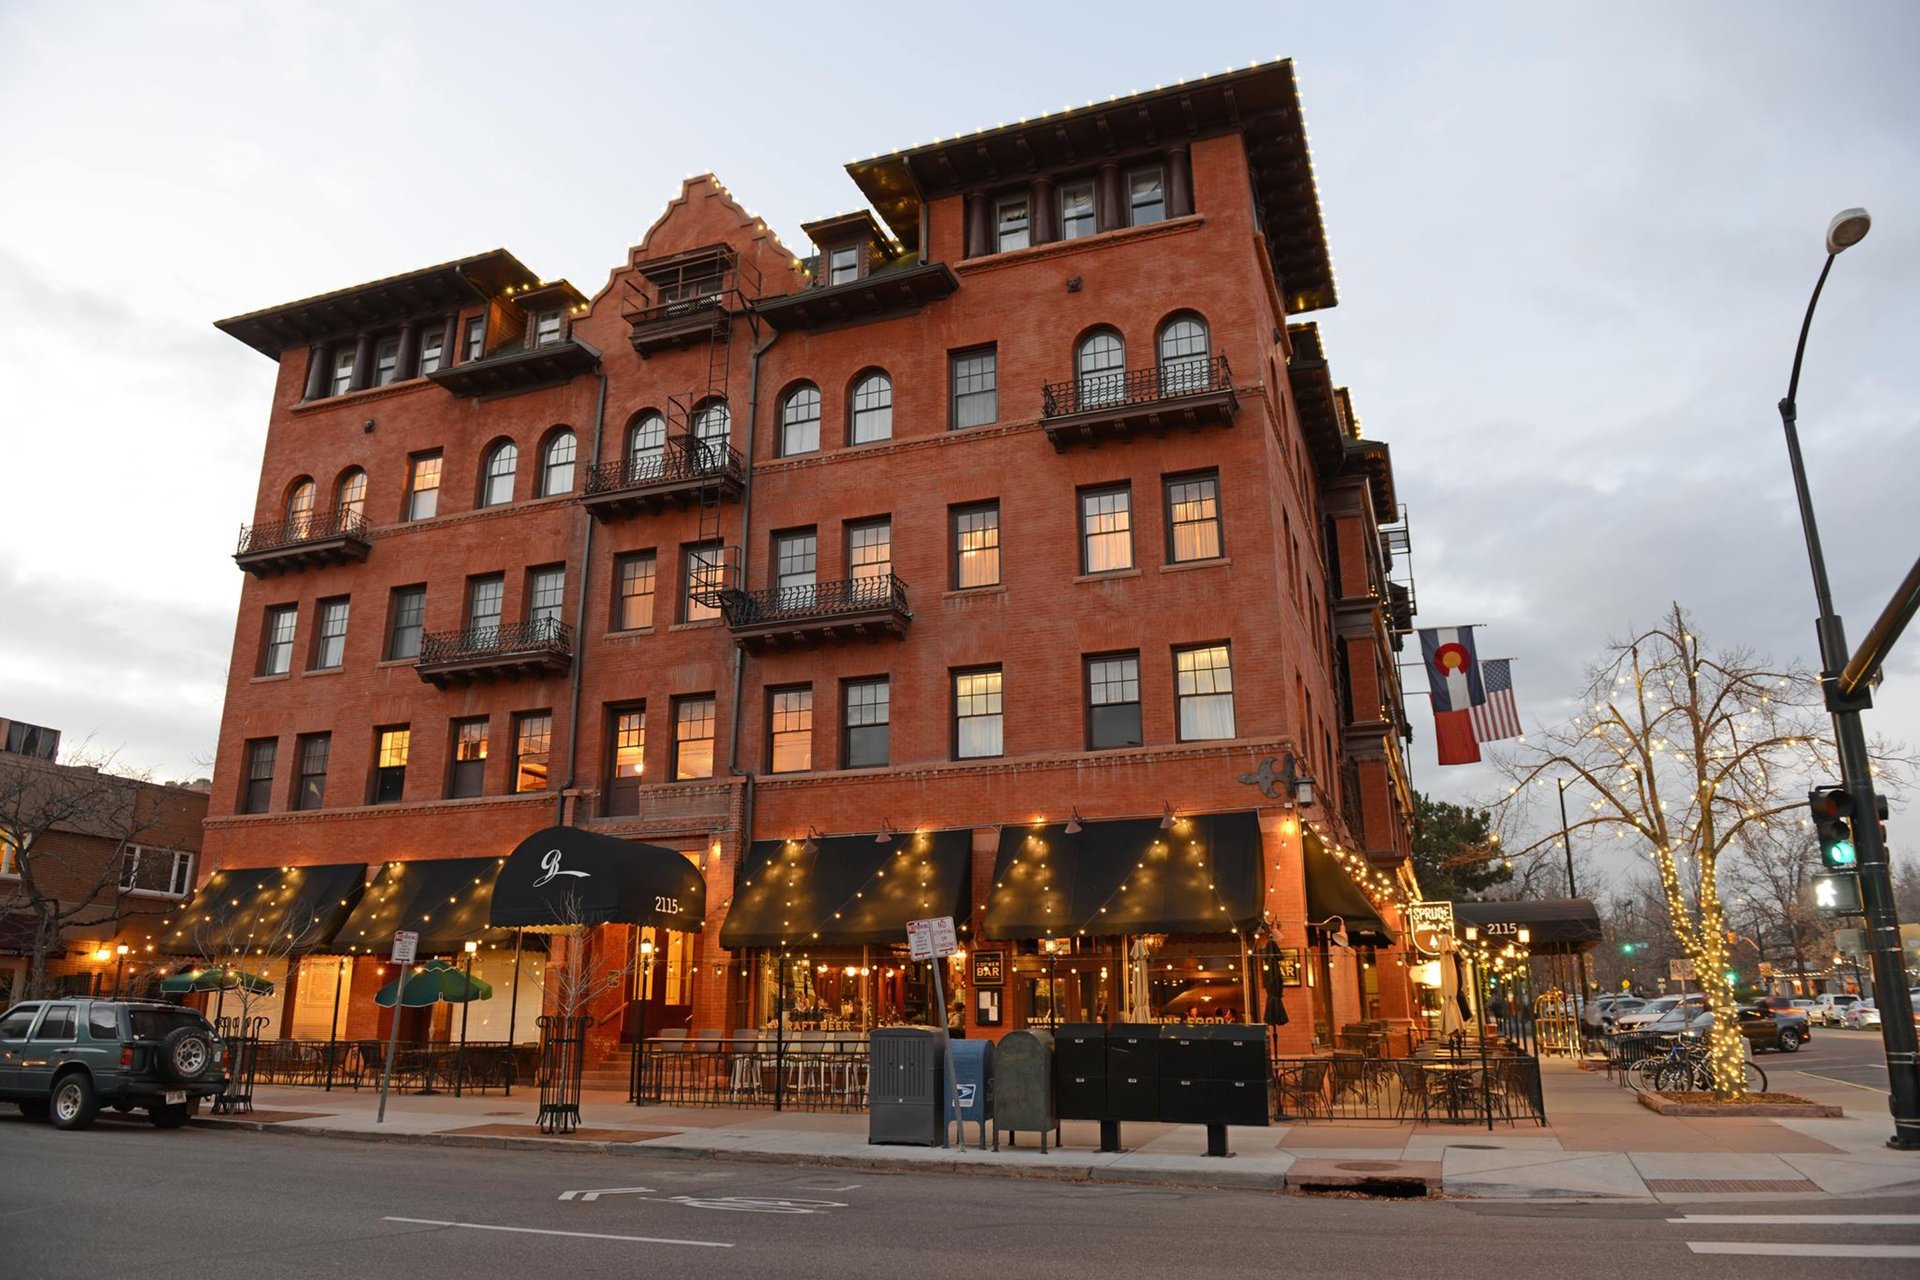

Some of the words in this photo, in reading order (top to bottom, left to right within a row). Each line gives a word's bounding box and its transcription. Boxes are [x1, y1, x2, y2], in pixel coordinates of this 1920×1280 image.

[655, 896, 678, 914] 2115
[1413, 906, 1450, 921] SPRUCE
[1487, 923, 1517, 935] 2115
[976, 967, 1000, 977] BAR
[1280, 966, 1295, 976] AR
[780, 1020, 816, 1031] RAFT
[820, 1020, 851, 1031] BEER
